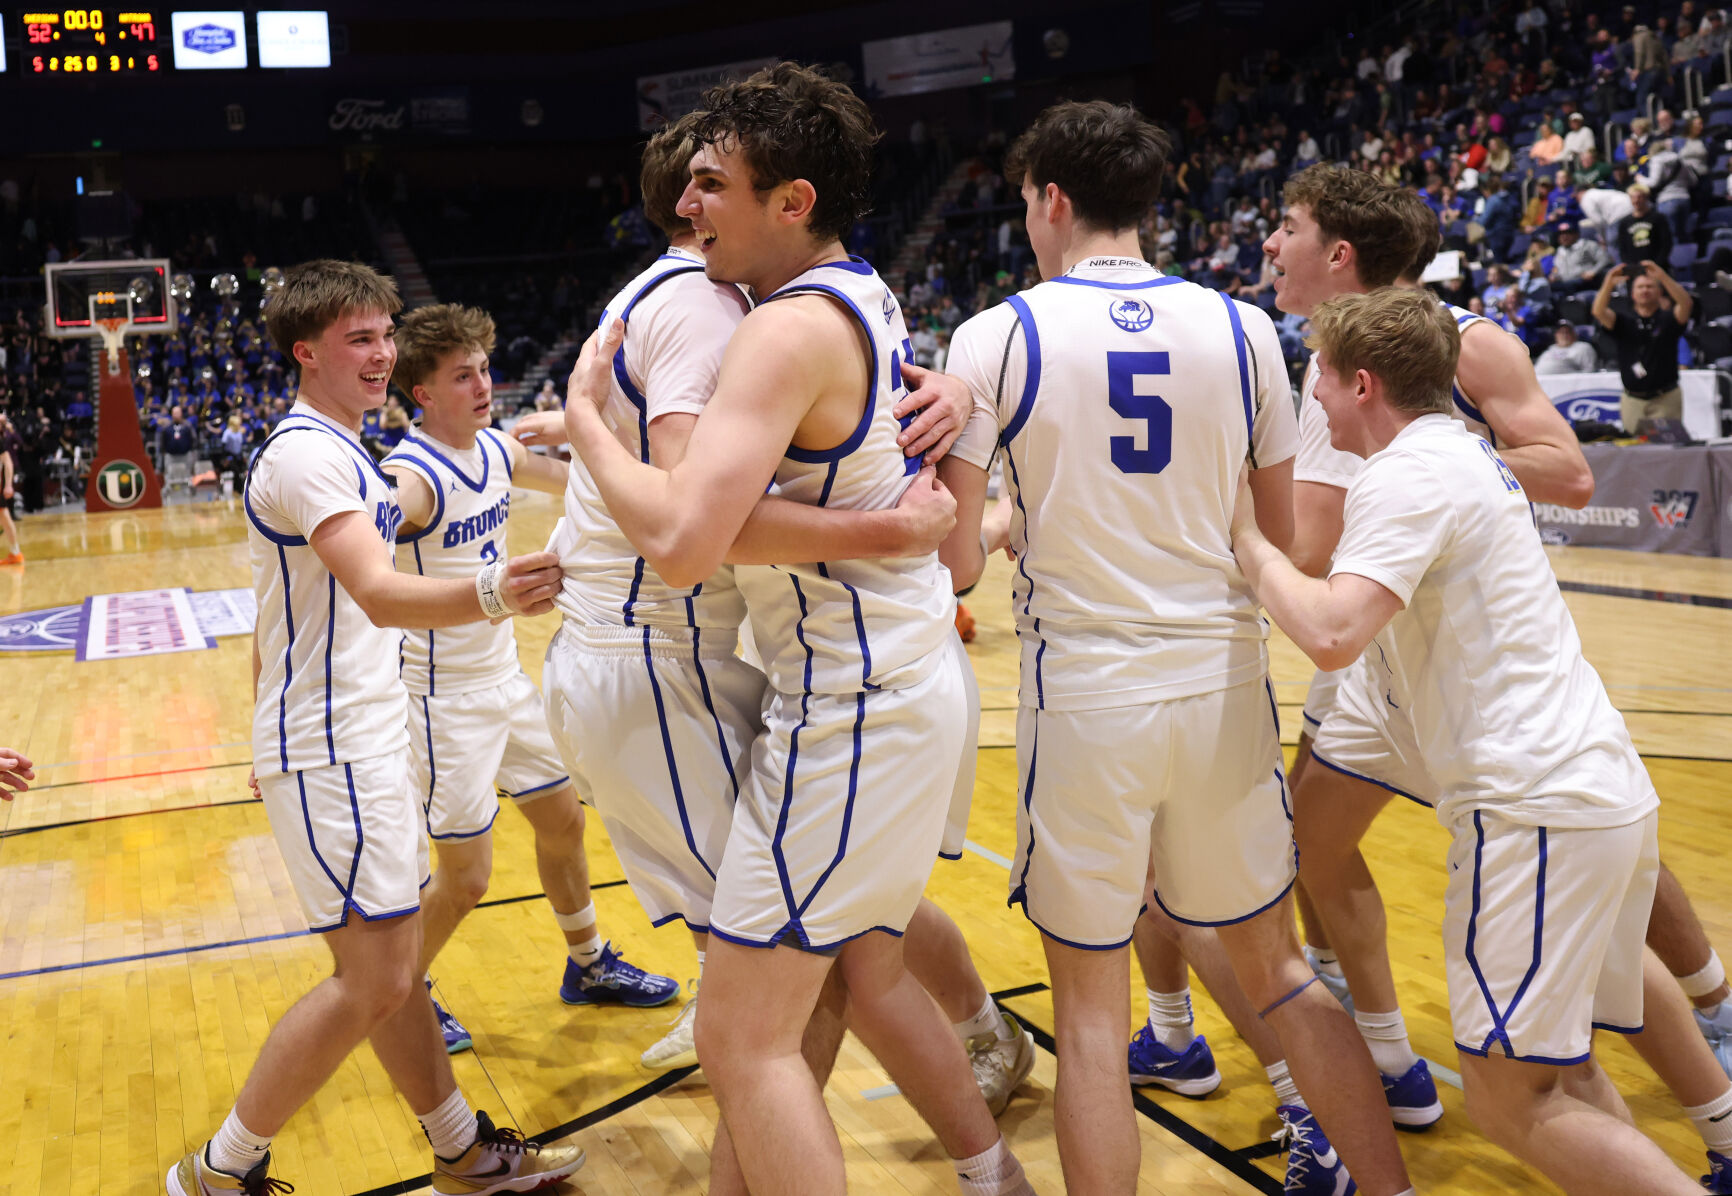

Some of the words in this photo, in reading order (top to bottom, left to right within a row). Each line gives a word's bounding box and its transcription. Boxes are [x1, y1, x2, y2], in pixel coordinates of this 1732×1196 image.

[28, 23, 52, 43] 52
[95, 31, 106, 45] 4
[131, 23, 155, 41] 47
[147, 54, 159, 71] 5
[328, 98, 405, 130] Ford
[1089, 259, 1117, 267] NIKE
[1119, 259, 1142, 267] PRO
[1106, 351, 1173, 474] 5
[104, 469, 138, 503] U
